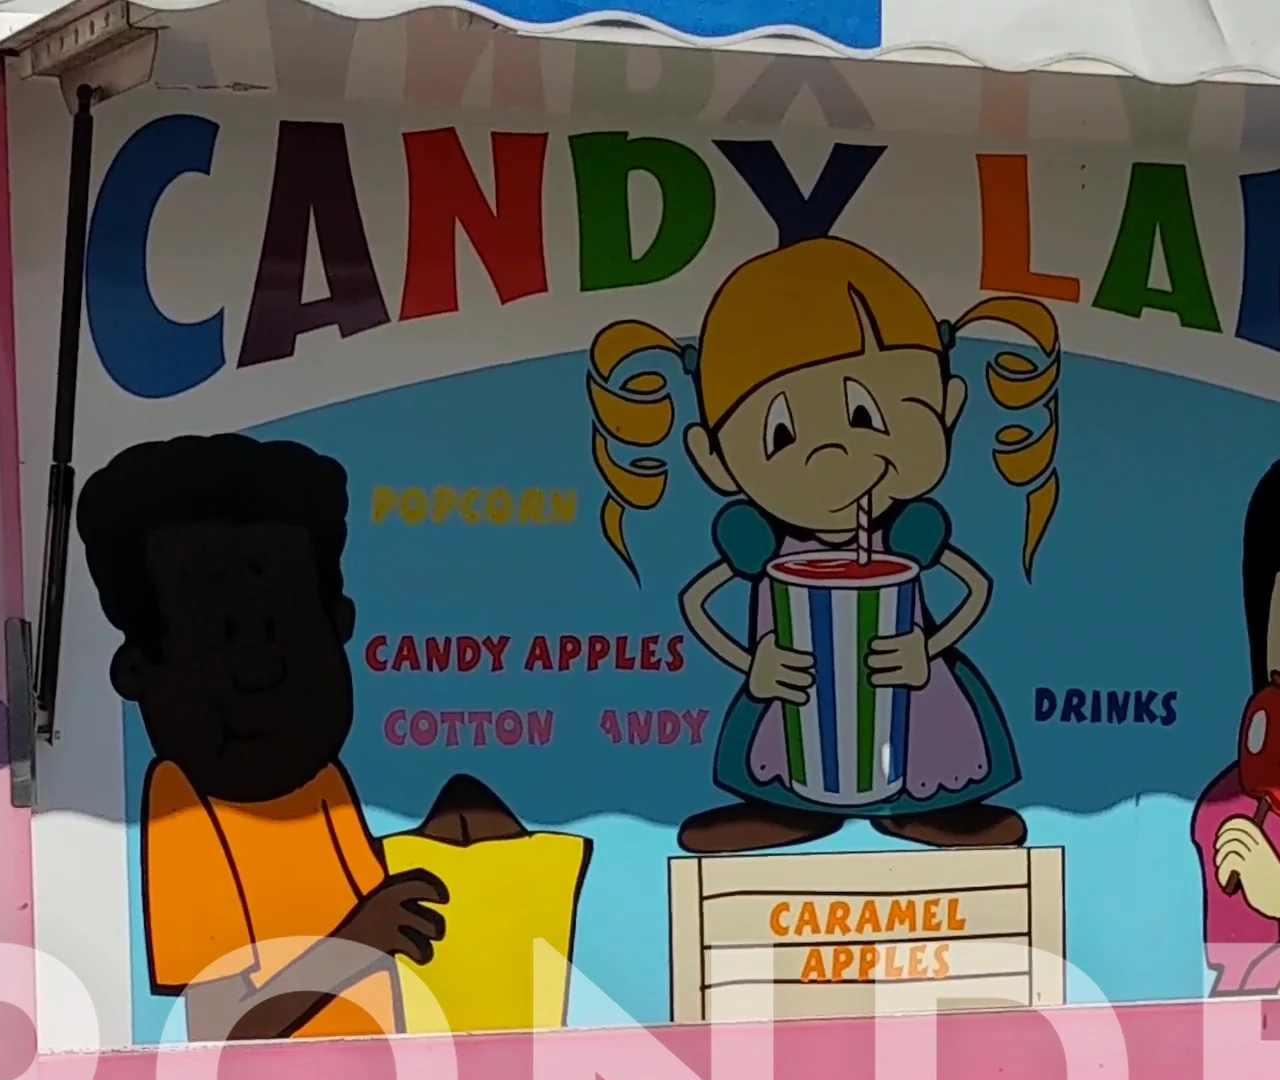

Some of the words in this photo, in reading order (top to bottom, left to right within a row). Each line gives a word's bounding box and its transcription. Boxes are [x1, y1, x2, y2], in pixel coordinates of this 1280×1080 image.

[86, 114, 888, 399] CANDY
[372, 485, 578, 526] POPCORN
[365, 635, 511, 673] CANDY
[524, 634, 685, 673] APPLES
[1034, 687, 1179, 726] DRINKS
[383, 709, 554, 747] COTTON
[769, 897, 967, 938] CARAMEL
[800, 943, 952, 984] APPLES
